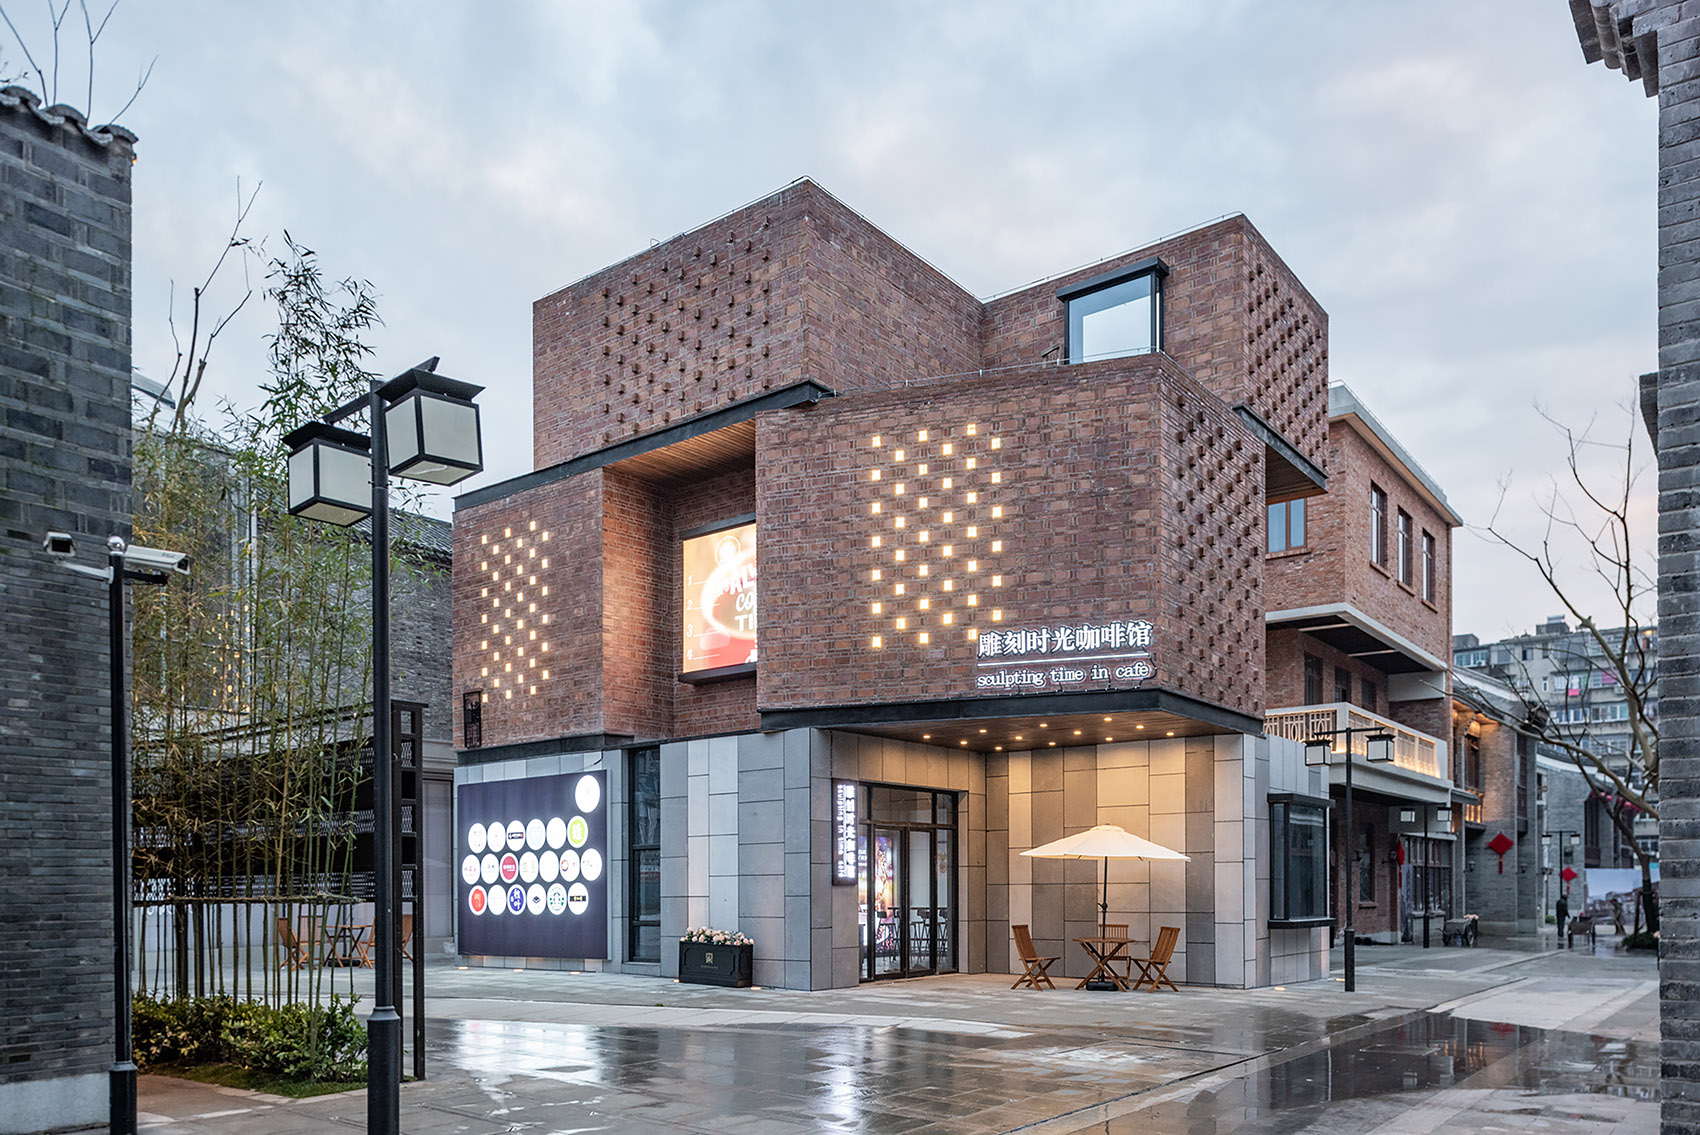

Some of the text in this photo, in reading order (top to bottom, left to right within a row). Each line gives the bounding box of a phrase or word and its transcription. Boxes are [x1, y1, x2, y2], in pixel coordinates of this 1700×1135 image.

[978, 621, 1153, 657] 雕刻时光咖啡馆
[977, 662, 1149, 688] sculpting time in cafe
